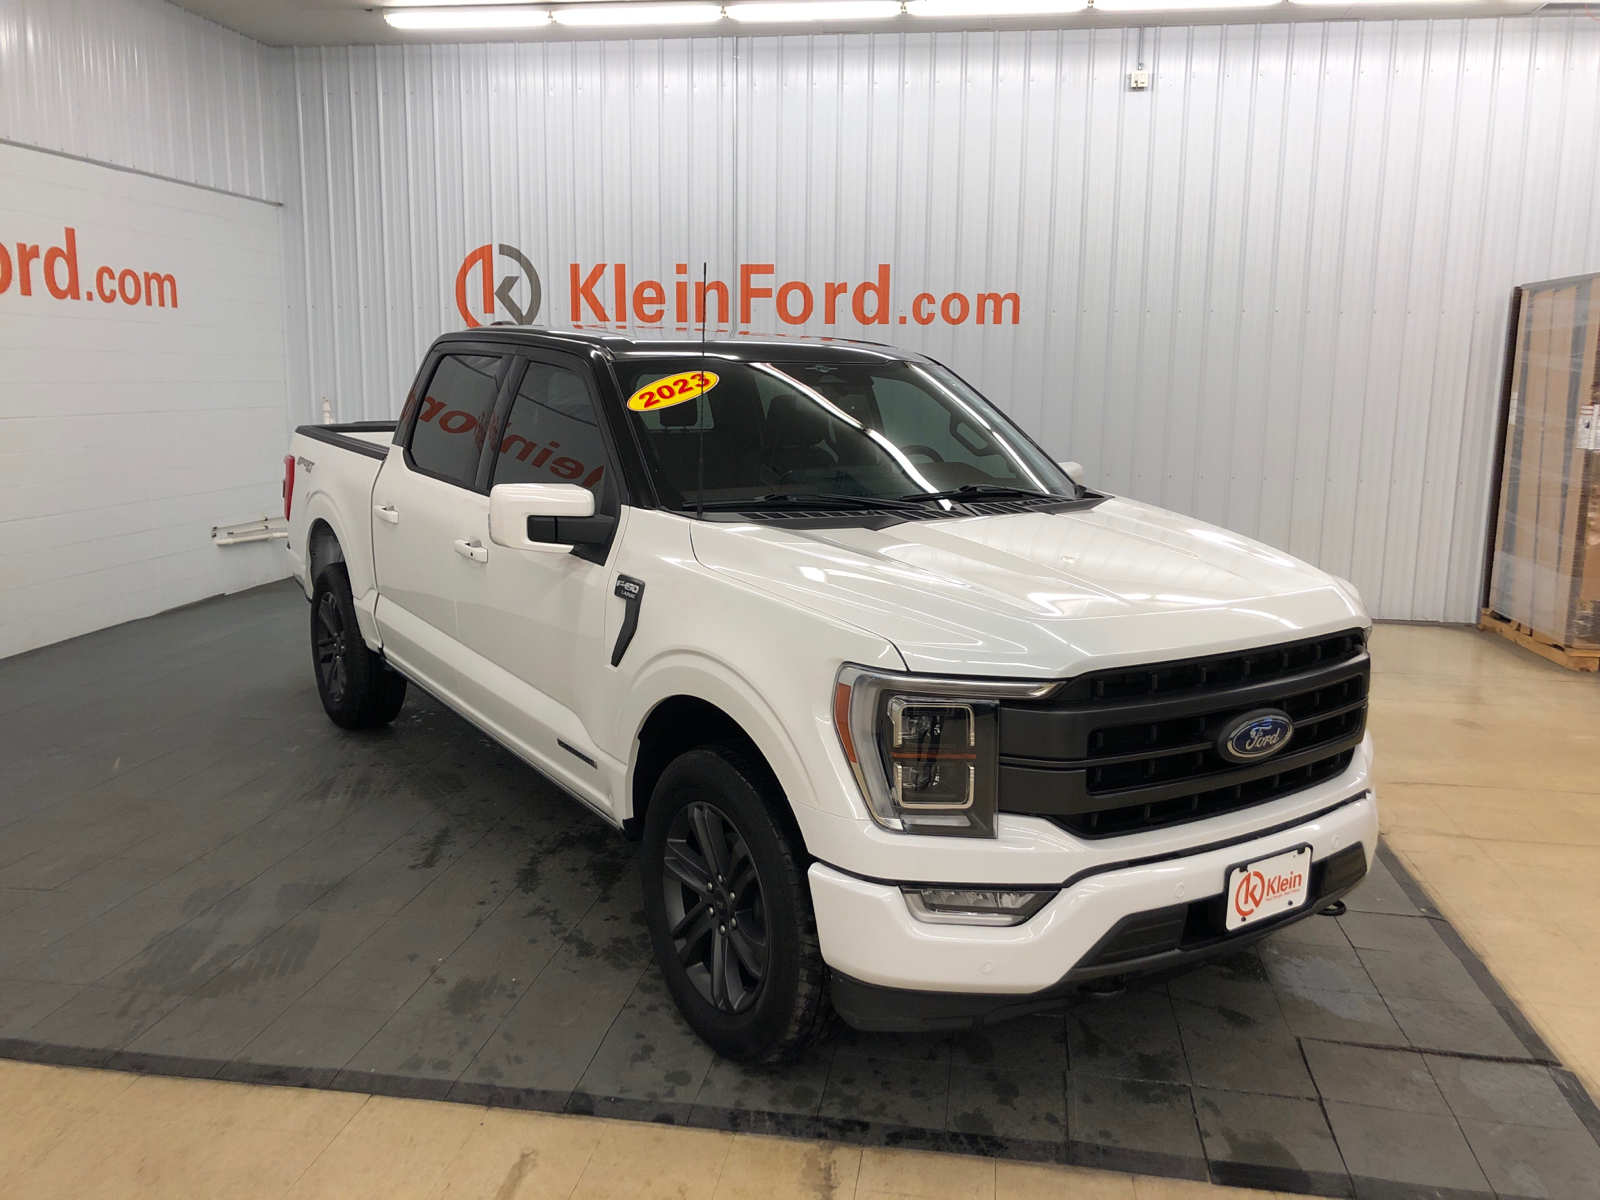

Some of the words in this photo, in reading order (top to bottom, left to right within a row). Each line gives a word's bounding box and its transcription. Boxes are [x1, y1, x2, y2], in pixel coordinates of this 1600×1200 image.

[569, 263, 1021, 326] KleinFord.com
[638, 373, 711, 408] 2023
[1245, 725, 1281, 750] Ford
[1266, 870, 1303, 897] Klein
